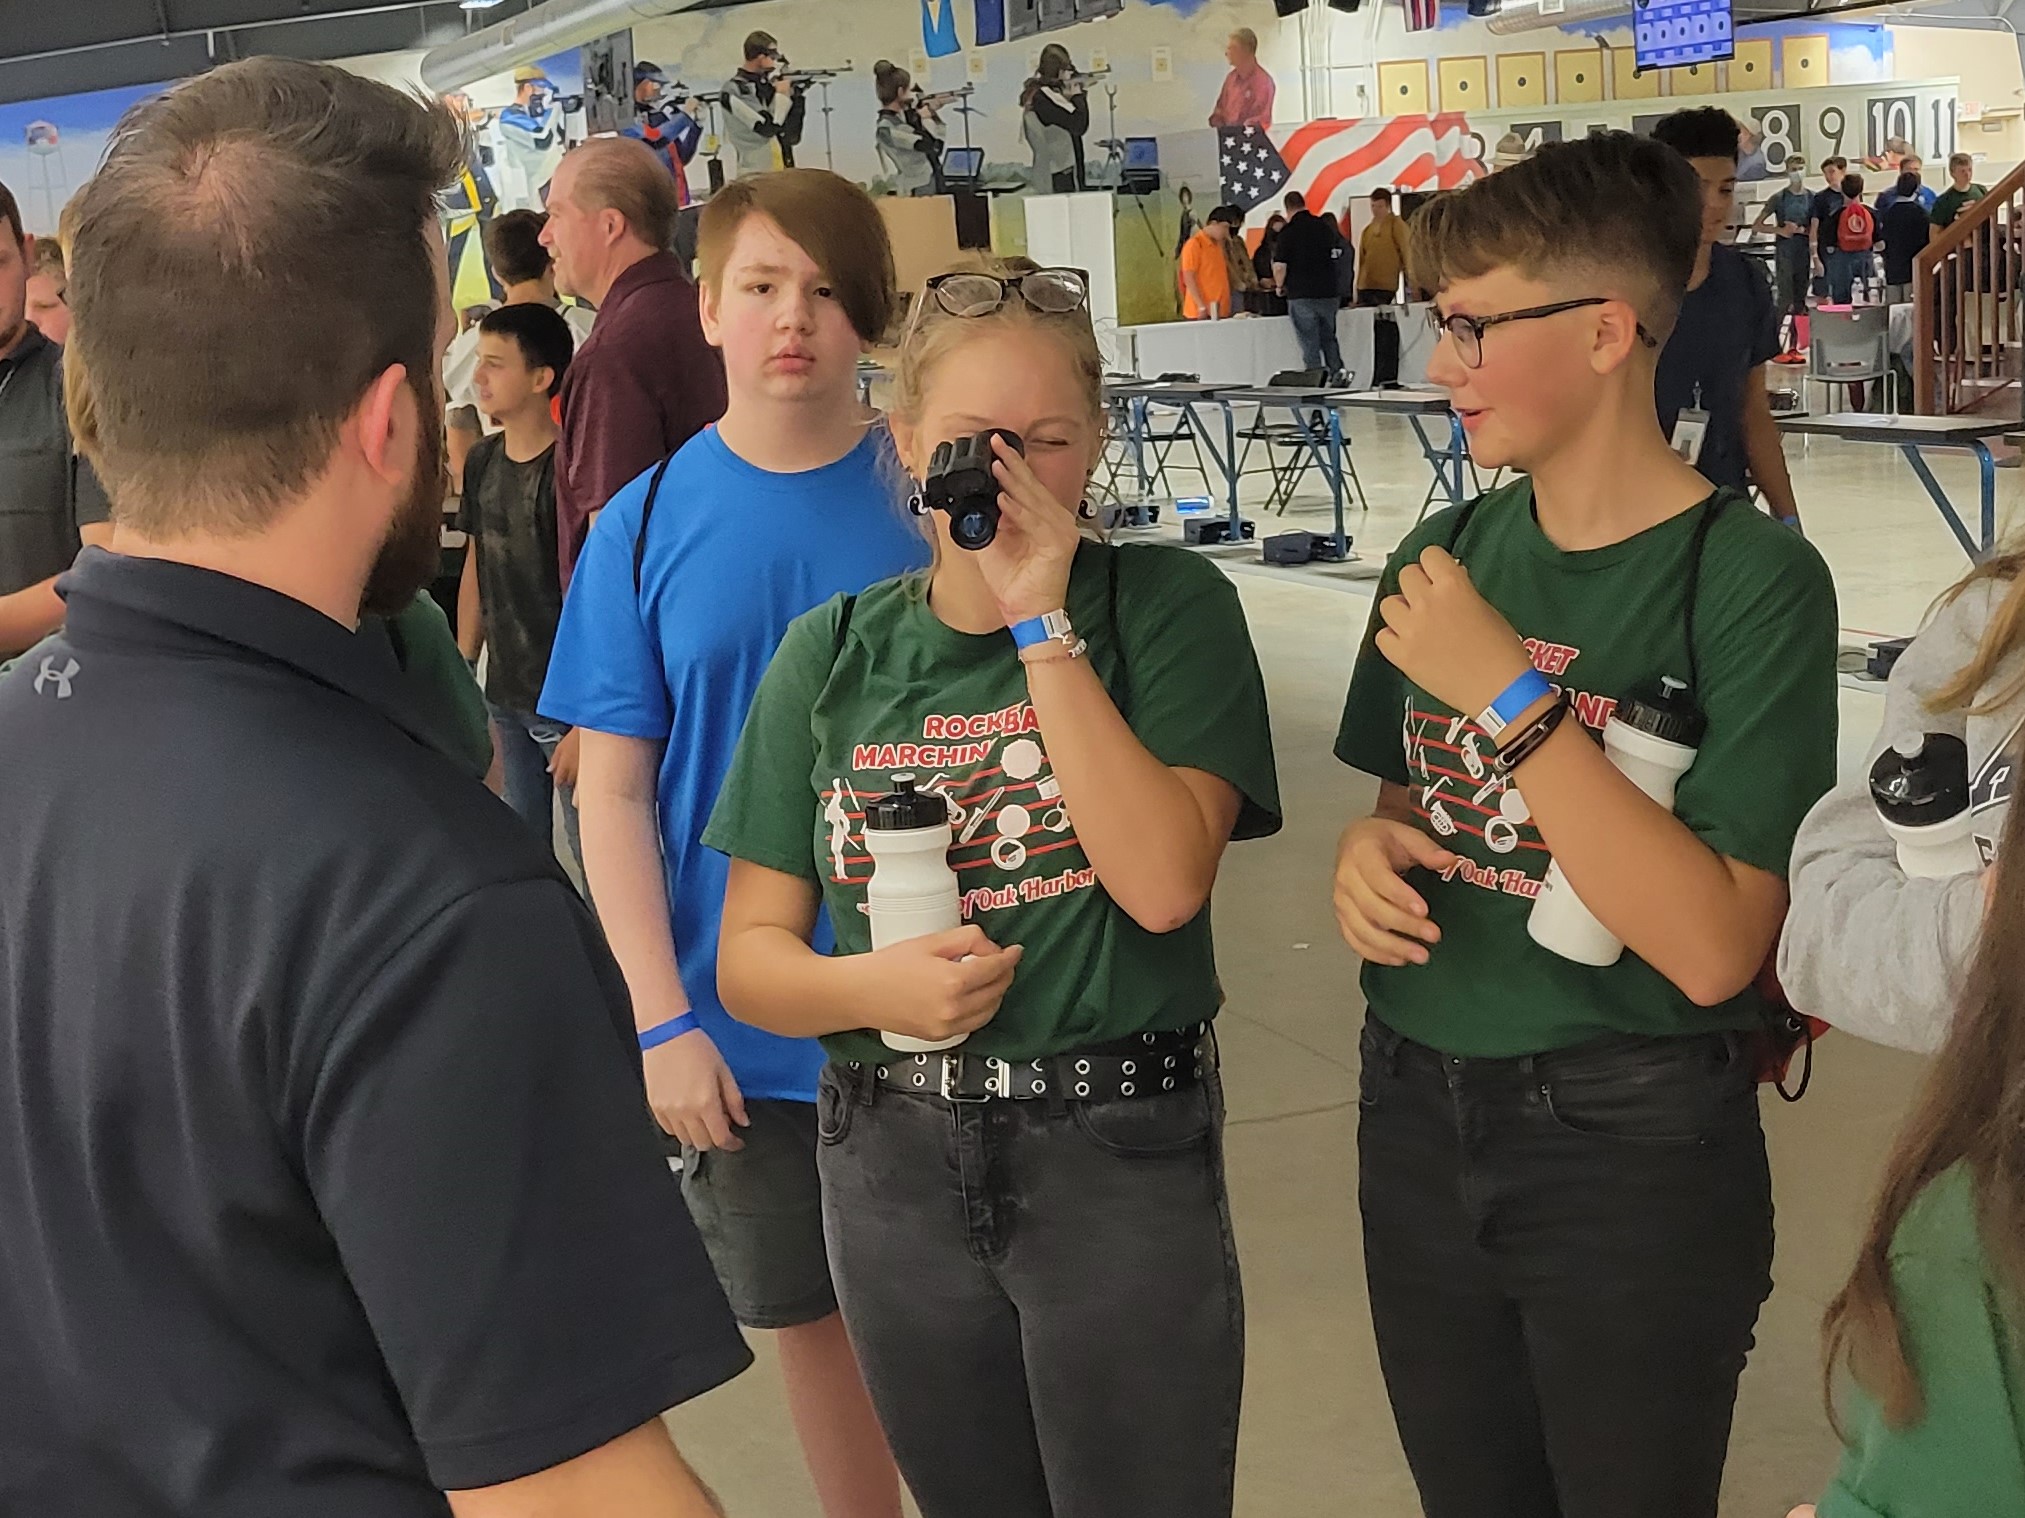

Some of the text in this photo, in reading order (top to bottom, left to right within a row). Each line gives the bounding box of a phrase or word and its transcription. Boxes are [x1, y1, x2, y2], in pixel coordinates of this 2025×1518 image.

[1760, 109, 1794, 172] 8
[1819, 106, 1846, 156] 9
[1872, 100, 1913, 157] 10
[1931, 97, 1956, 159] 11
[853, 738, 992, 771] MARCHIN
[975, 883, 1019, 911] Oak
[1019, 867, 1096, 902] Harbor
[1460, 860, 1498, 890] Oak
